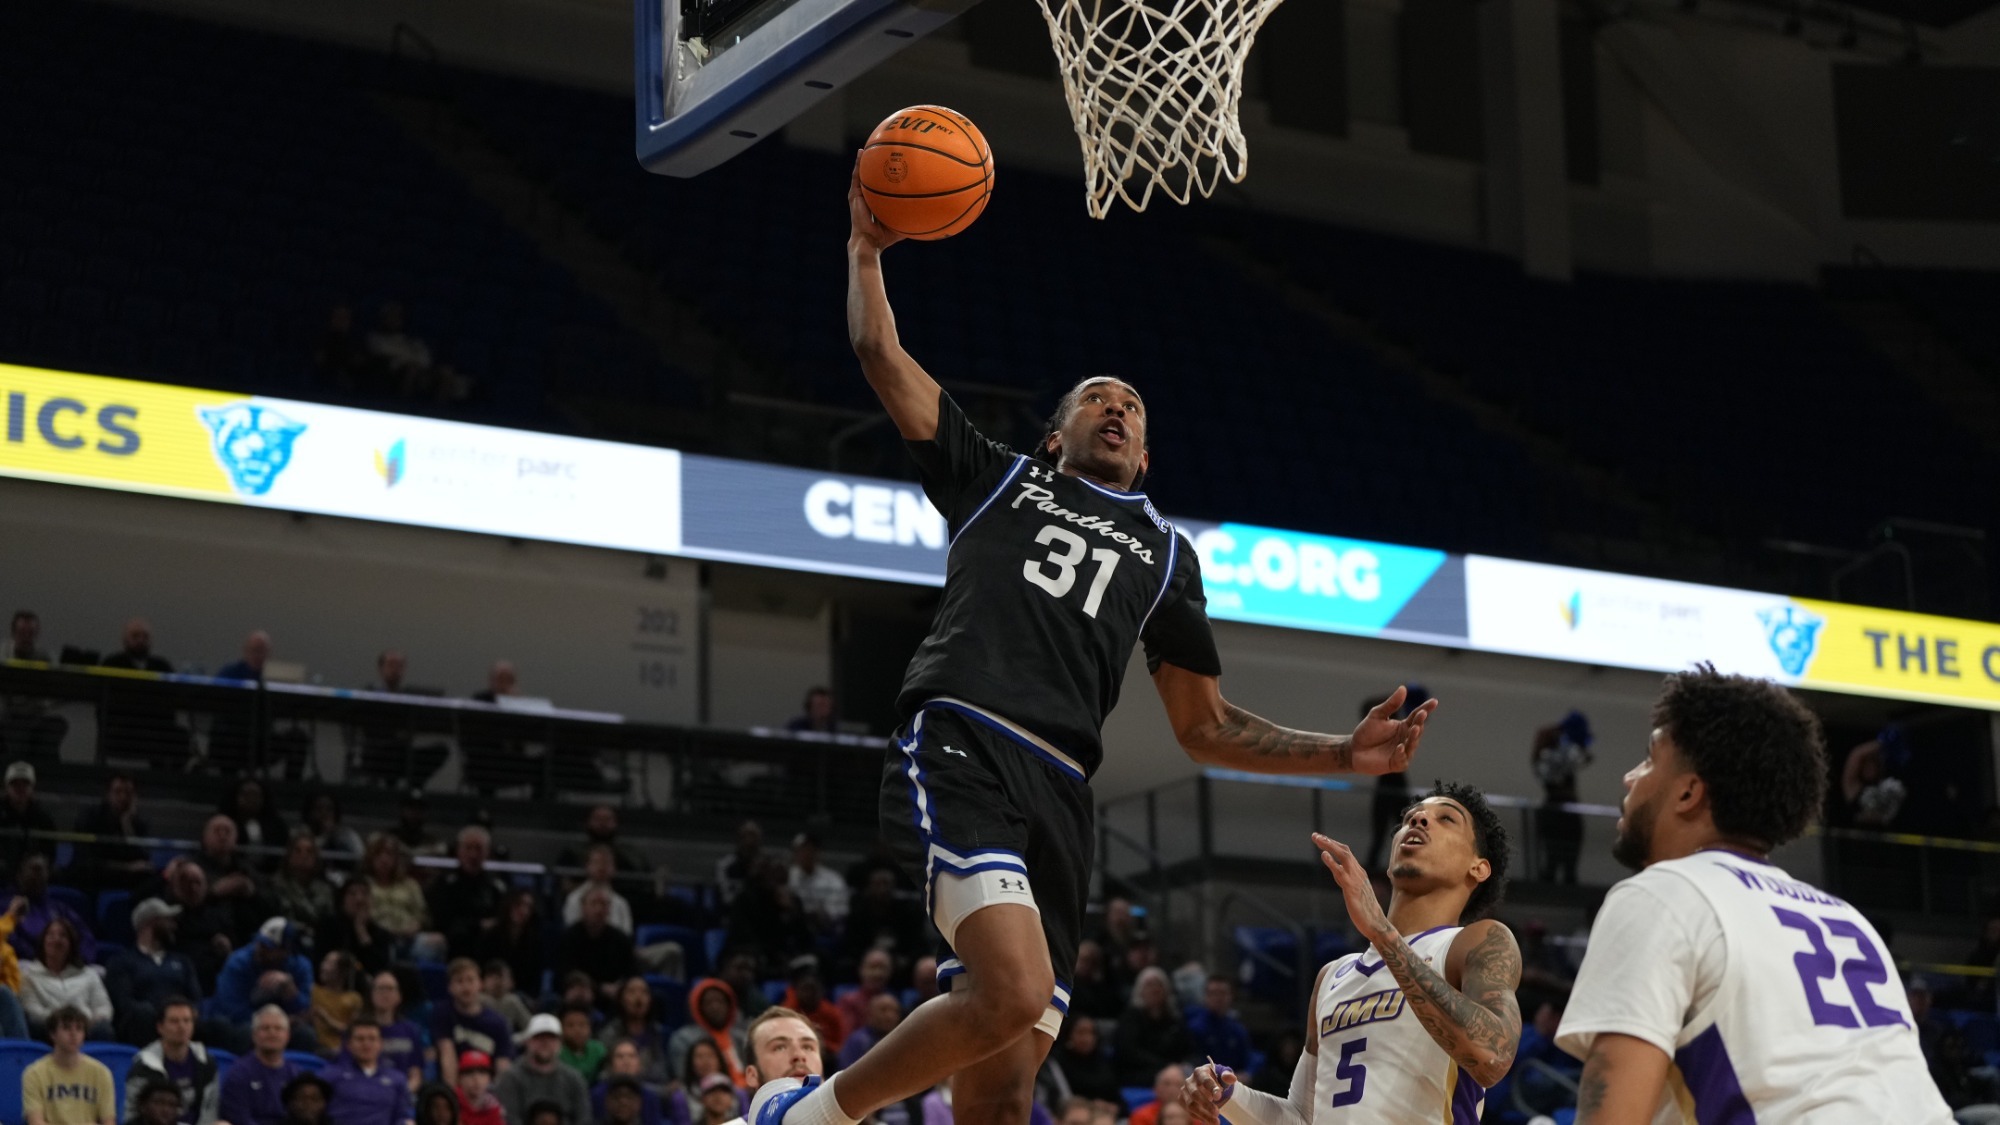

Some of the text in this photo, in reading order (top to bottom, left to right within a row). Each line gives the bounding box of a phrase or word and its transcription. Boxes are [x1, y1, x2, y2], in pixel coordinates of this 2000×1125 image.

[884, 116, 936, 134] EVO
[7, 391, 141, 456] ICS
[1011, 482, 1155, 564] Panthers
[1022, 524, 1122, 619] 31
[1174, 526, 1381, 602] C.ORG
[1863, 629, 1960, 678] THE
[1770, 905, 1912, 1031] 22
[1321, 988, 1407, 1038] JMU
[1332, 1037, 1367, 1108] 5
